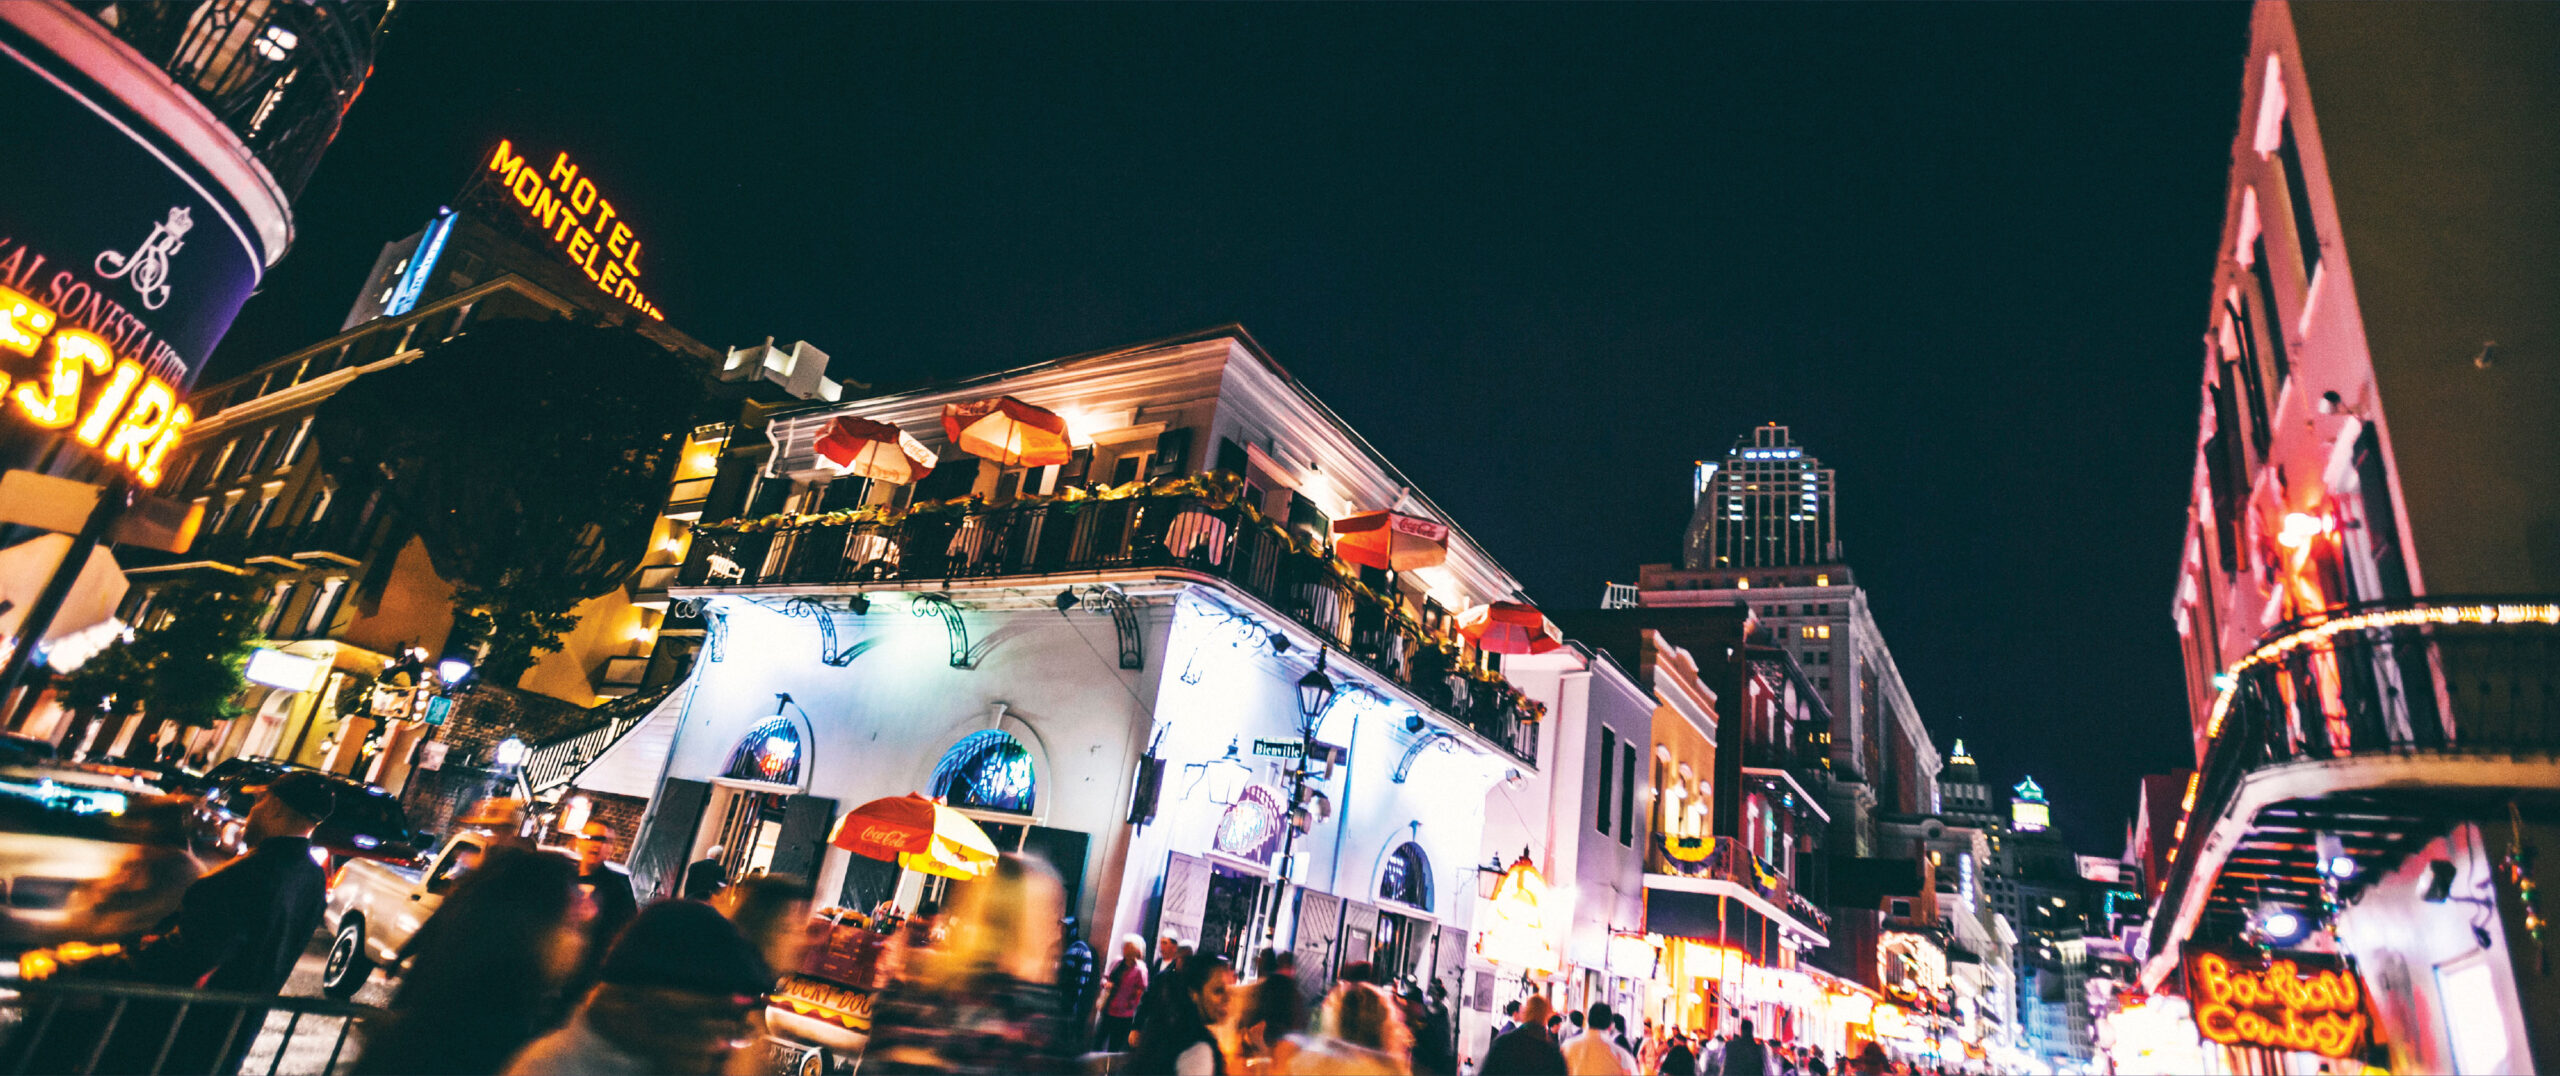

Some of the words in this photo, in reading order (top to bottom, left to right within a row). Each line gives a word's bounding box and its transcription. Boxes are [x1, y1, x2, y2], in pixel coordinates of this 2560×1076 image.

[489, 138, 664, 322] MONTELEO
[549, 151, 641, 277] HOTEL
[1255, 743, 1301, 758] Bienville
